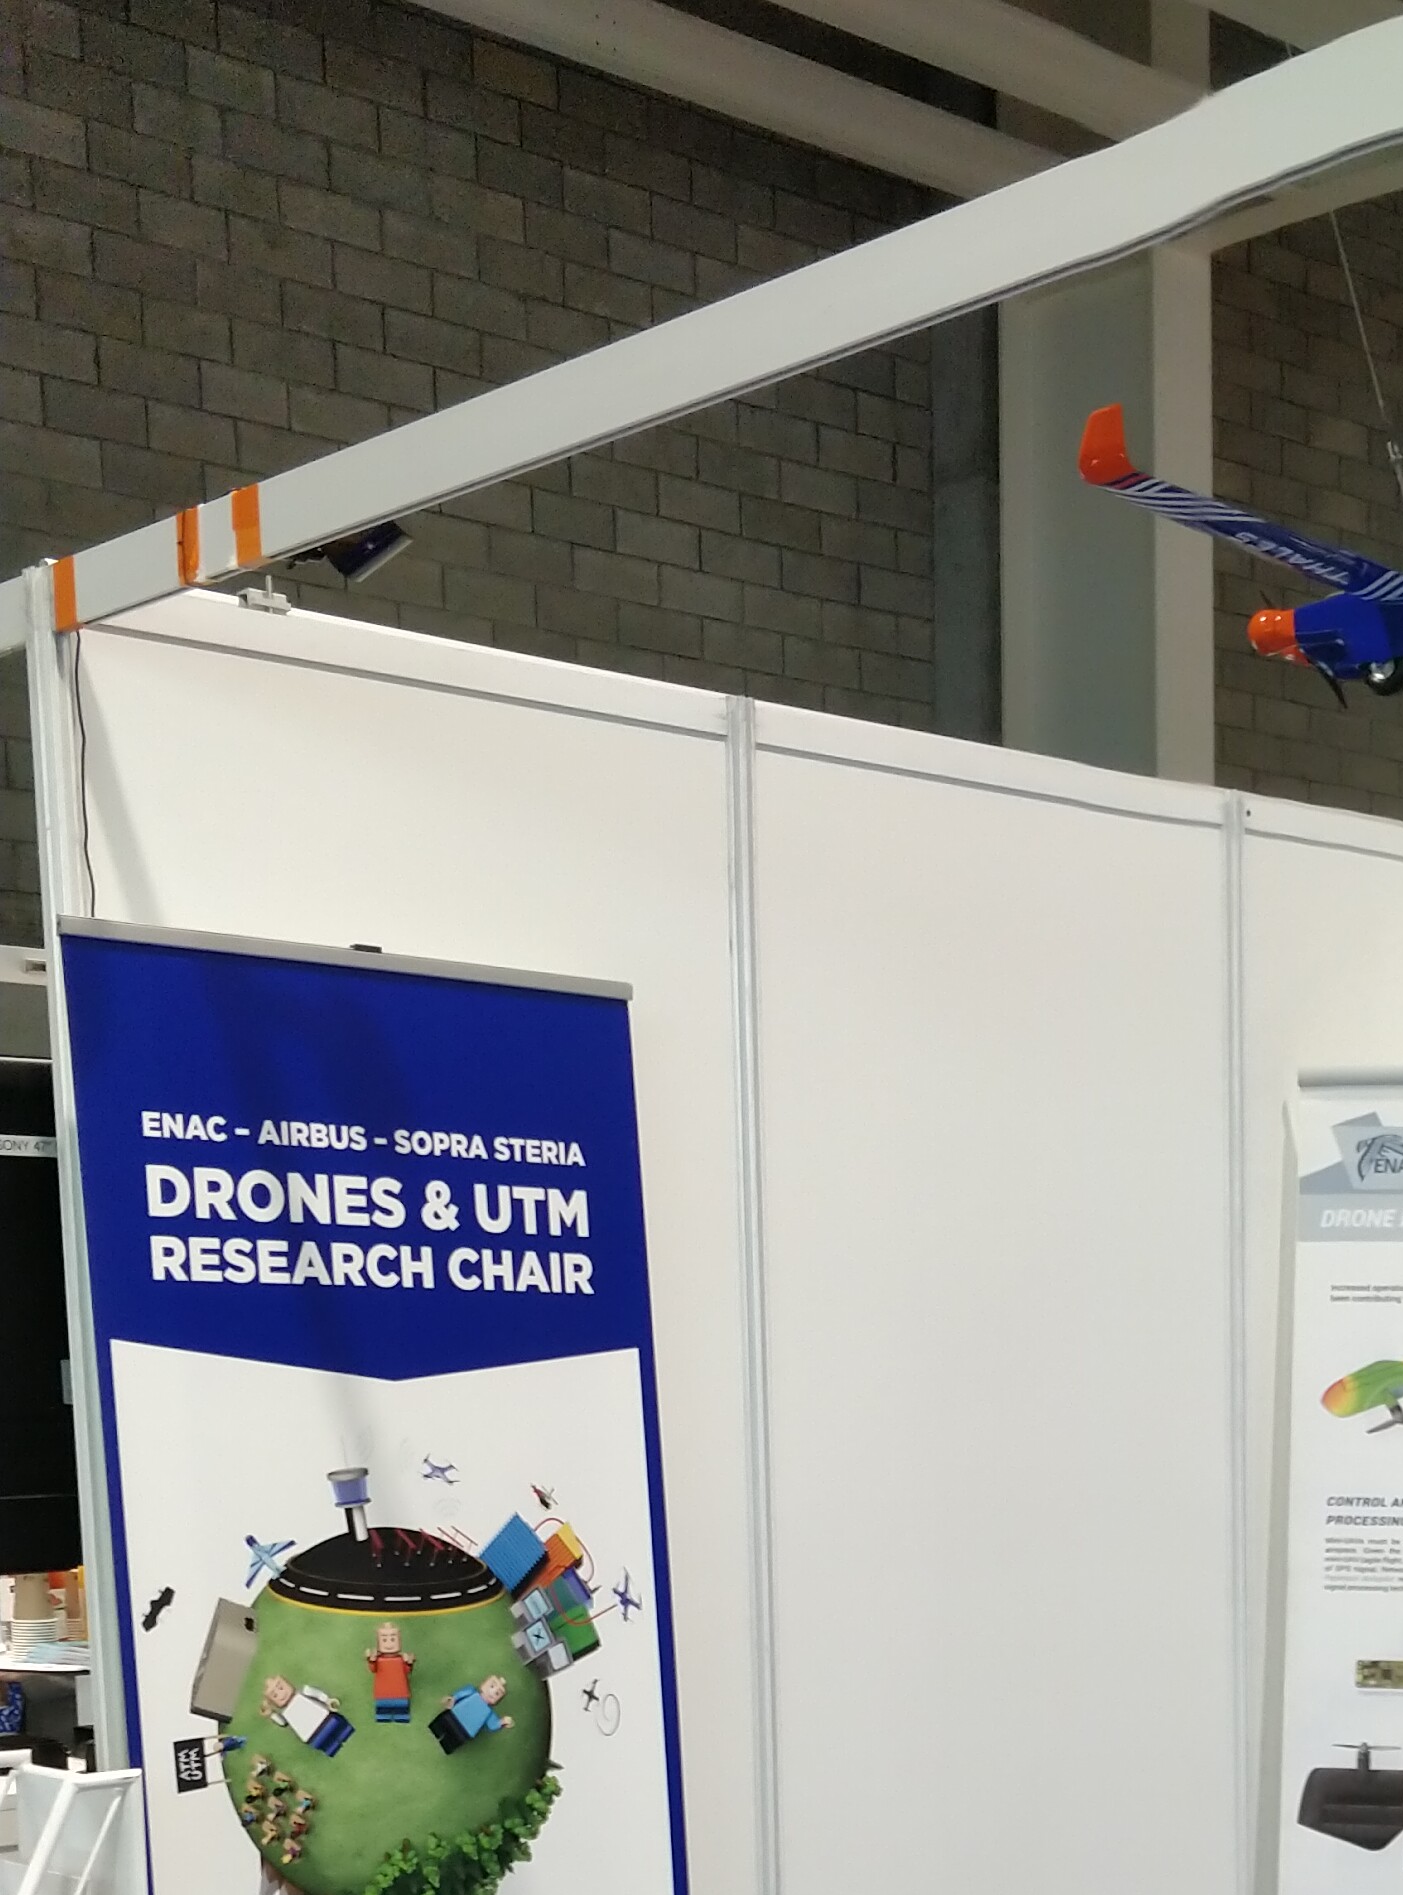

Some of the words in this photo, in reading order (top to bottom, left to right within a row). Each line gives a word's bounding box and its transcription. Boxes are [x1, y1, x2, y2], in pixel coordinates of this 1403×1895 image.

[141, 1110, 228, 1141] ENAC
[258, 1120, 368, 1151] AIRBUS
[394, 1129, 488, 1160] SOPRA
[493, 1136, 586, 1167] STERIA
[145, 1163, 407, 1229] DRONES
[421, 1179, 461, 1232] &
[473, 1183, 590, 1238] UTM
[1321, 1208, 1396, 1228] DRONE
[149, 1235, 435, 1290] RESEARCH
[447, 1246, 595, 1295] CHAIR
[1326, 1496, 1387, 1509] CONTROL
